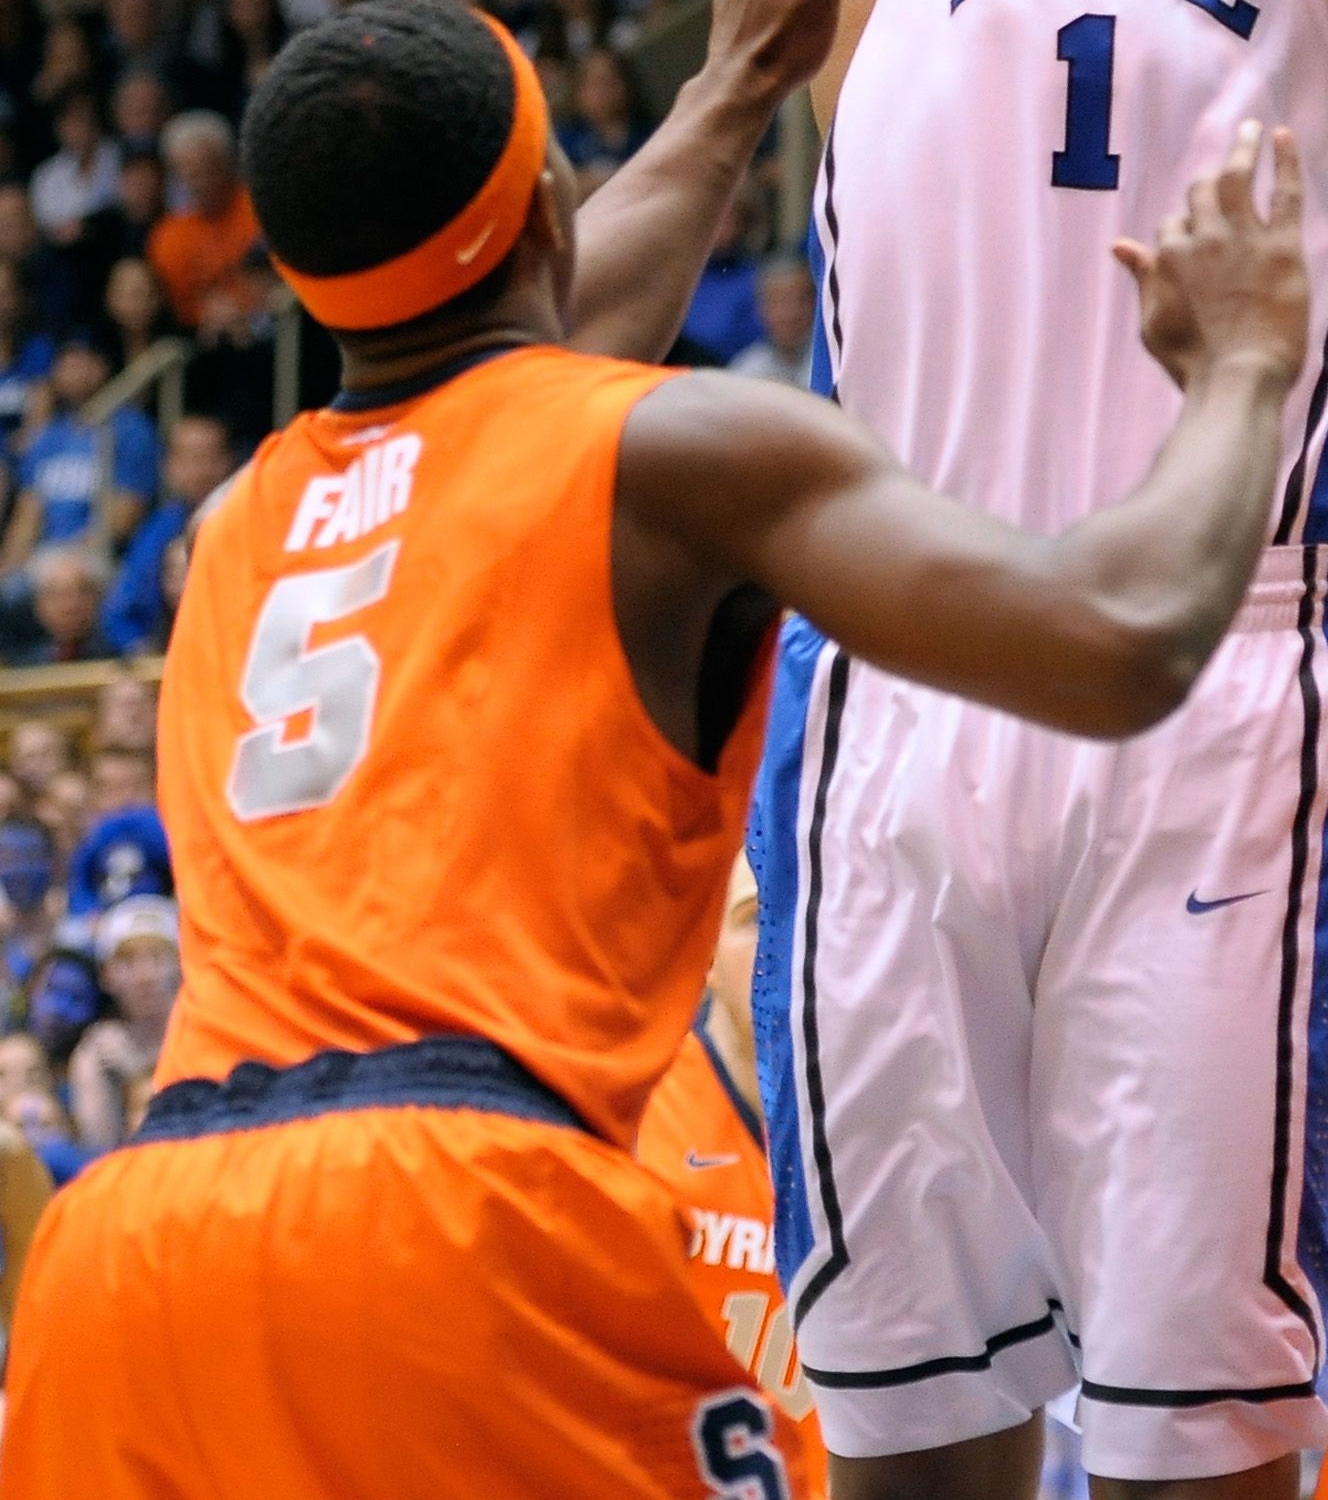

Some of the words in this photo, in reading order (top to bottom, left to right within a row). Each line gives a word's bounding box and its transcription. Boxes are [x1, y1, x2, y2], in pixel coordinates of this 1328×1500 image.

[1051, 13, 1120, 190] 1
[282, 432, 422, 553] FAIR
[224, 538, 401, 823] 5
[689, 1206, 776, 1276] YR
[692, 1386, 792, 1500] S
